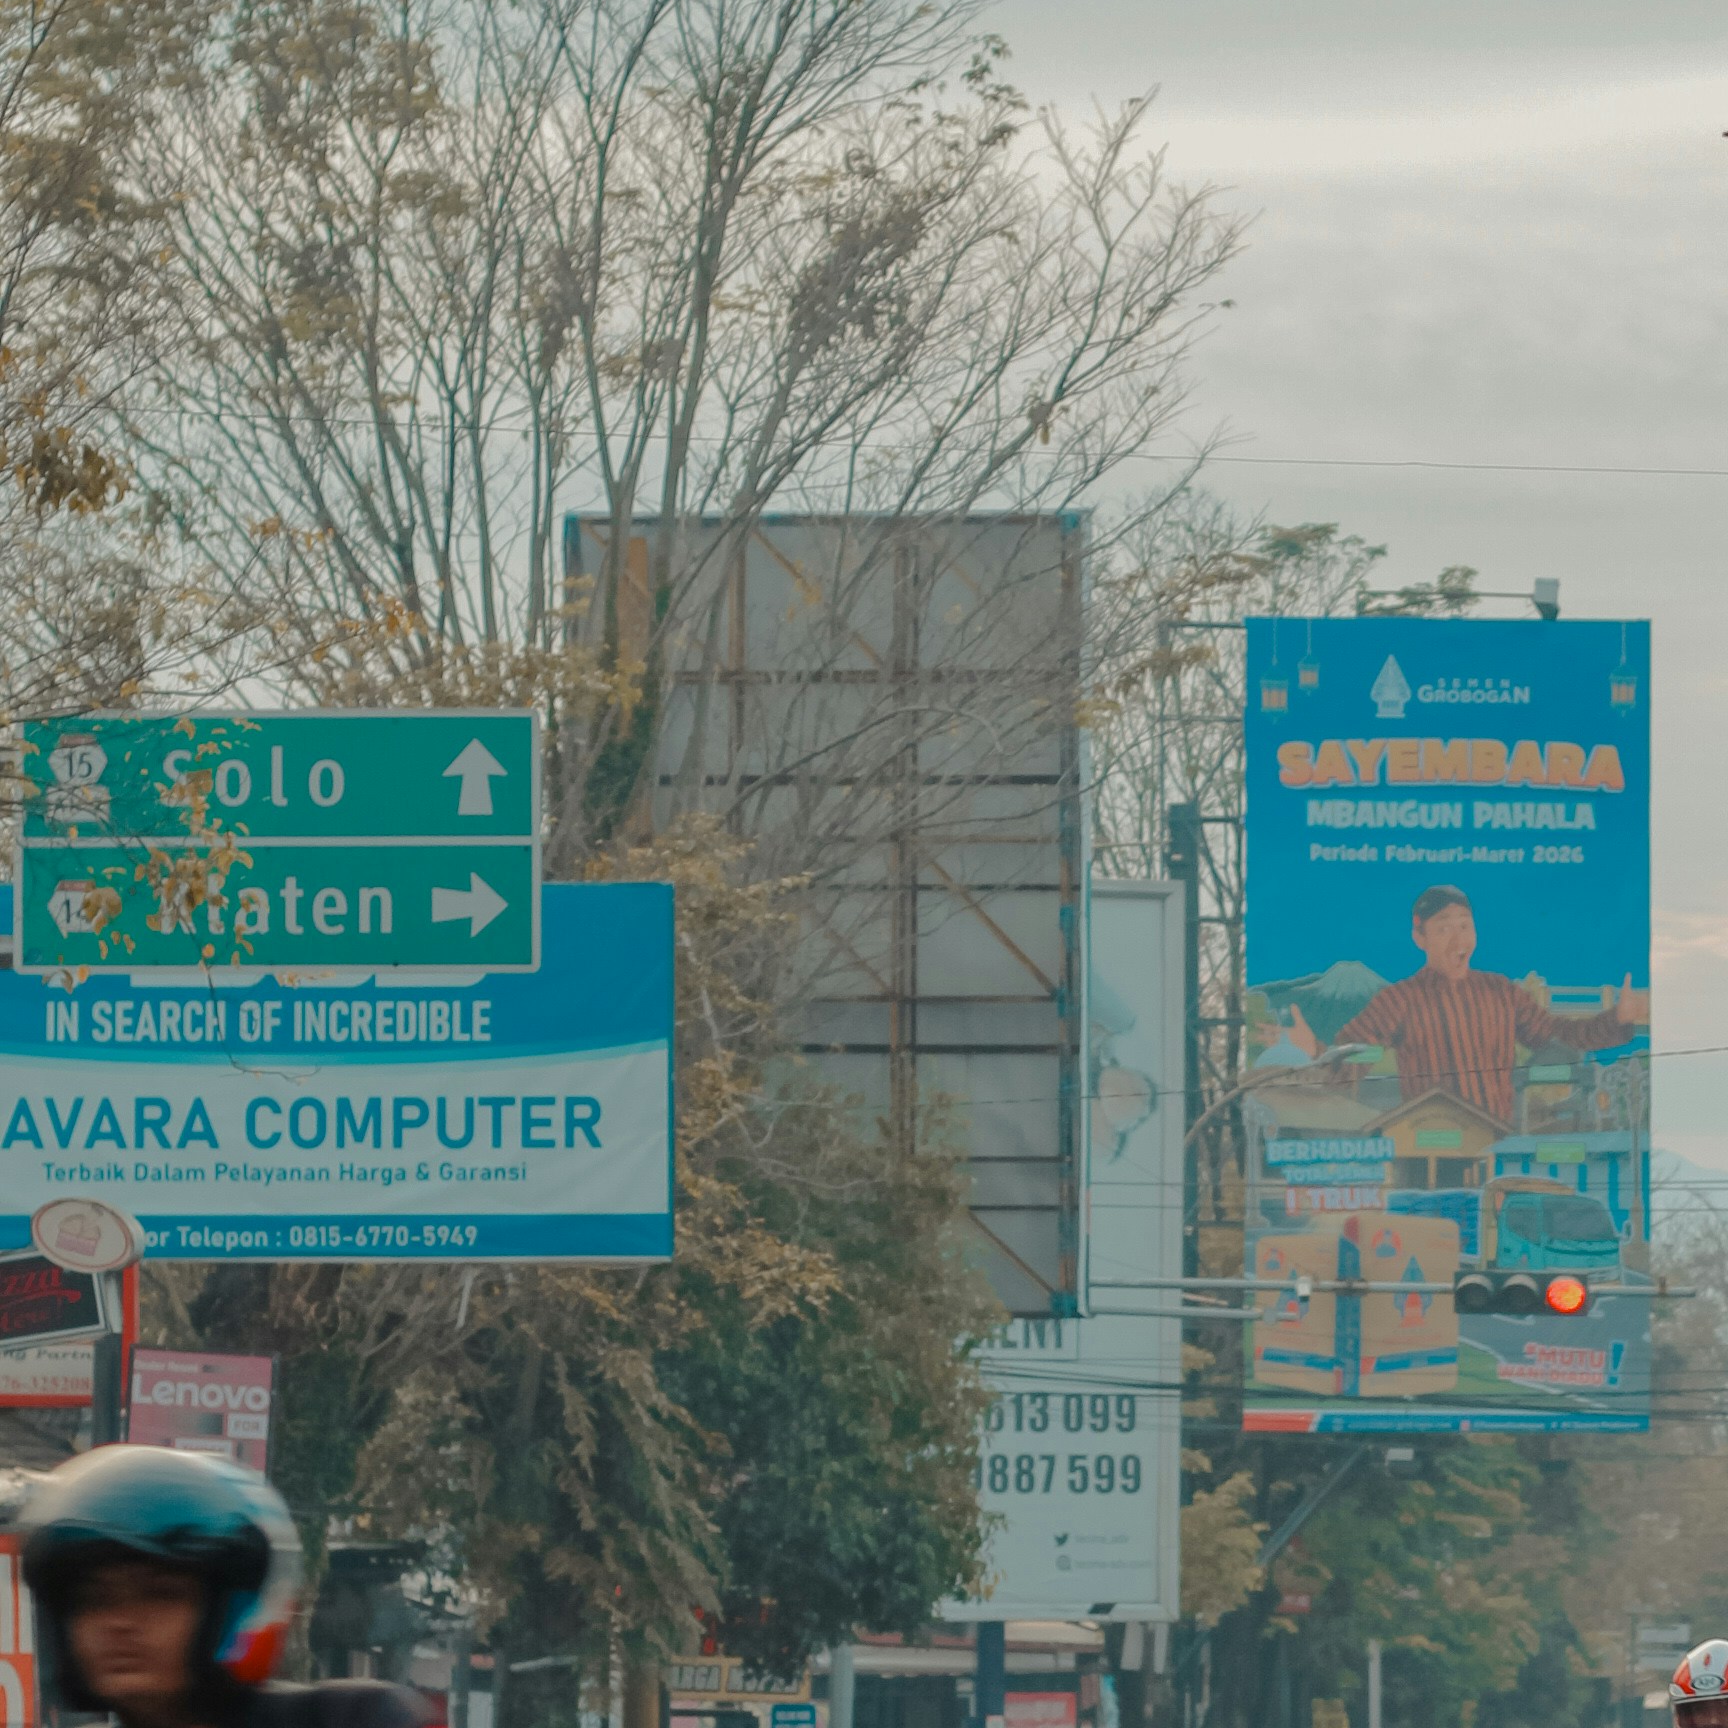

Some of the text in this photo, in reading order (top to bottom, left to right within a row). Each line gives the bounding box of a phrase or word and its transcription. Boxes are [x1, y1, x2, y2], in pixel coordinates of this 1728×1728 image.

[1417, 684, 1531, 704] GROBOGAN
[64, 751, 93, 778] 15
[162, 745, 345, 807] Solo
[1277, 738, 1625, 791] SAYEMBARA
[1306, 800, 1596, 830] MBANGUN PAHALA
[1309, 843, 1378, 862] Periode
[1532, 845, 1585, 864] 2026
[46, 999, 492, 1043] IN SEARCH OF INCREDIBLE
[244, 1094, 603, 1150] COMPUTER
[42, 1161, 527, 1186] Terbaik Dalam Pelayanan Harga & Garansi
[177, 1226, 269, 1252] Telepon
[289, 1225, 478, 1248] 0815-6770-5949
[131, 1373, 270, 1412] Lenovo
[1062, 1393, 1136, 1433] 099
[1067, 1453, 1142, 1494] 599
